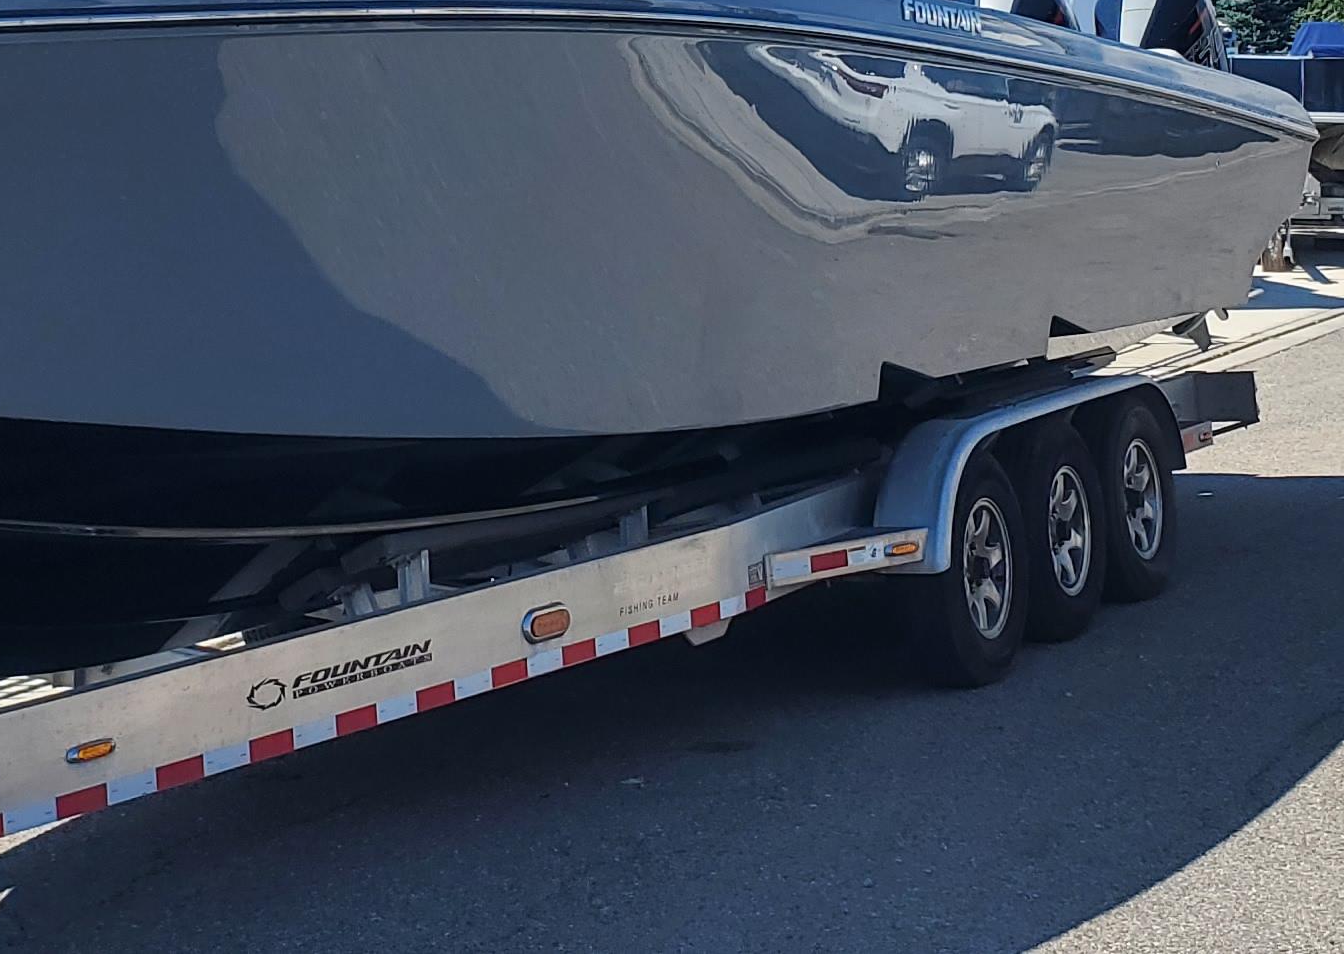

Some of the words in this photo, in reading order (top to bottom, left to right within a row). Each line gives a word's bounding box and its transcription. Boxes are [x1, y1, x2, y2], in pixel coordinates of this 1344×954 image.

[619, 602, 654, 617] FISHING
[657, 593, 679, 607] TEAM
[292, 638, 432, 688] FOUNTAIN
[294, 653, 432, 698] POWERBOATS
